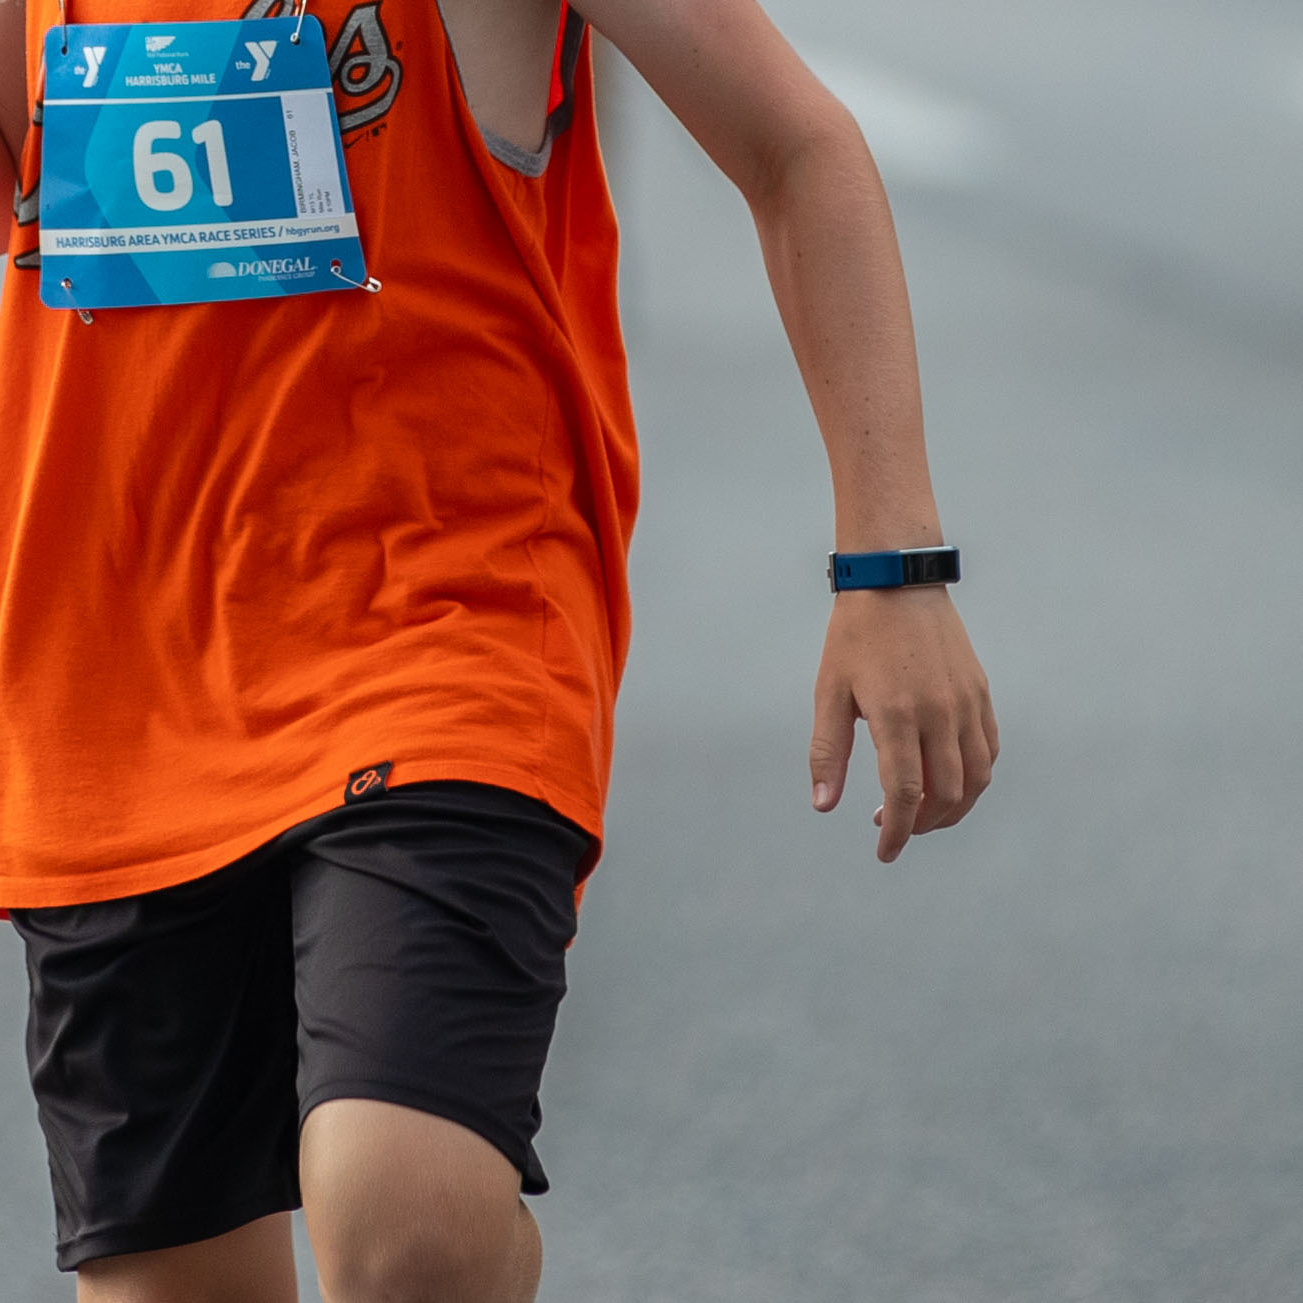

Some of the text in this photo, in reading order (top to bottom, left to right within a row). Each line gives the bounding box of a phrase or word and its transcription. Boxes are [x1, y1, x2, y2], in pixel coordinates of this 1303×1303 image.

[153, 62, 183, 74] YMCA
[125, 72, 217, 87] HARRISBURG MILE
[288, 129, 298, 157] JACOB
[133, 119, 234, 212] 61
[55, 235, 126, 249] HARRISBURG
[128, 234, 161, 247] AREA
[161, 232, 198, 245] YMCA
[199, 229, 232, 243] RACE
[234, 226, 276, 240] SERIES
[278, 225, 283, 237] /
[238, 256, 315, 277] DONEGAL
